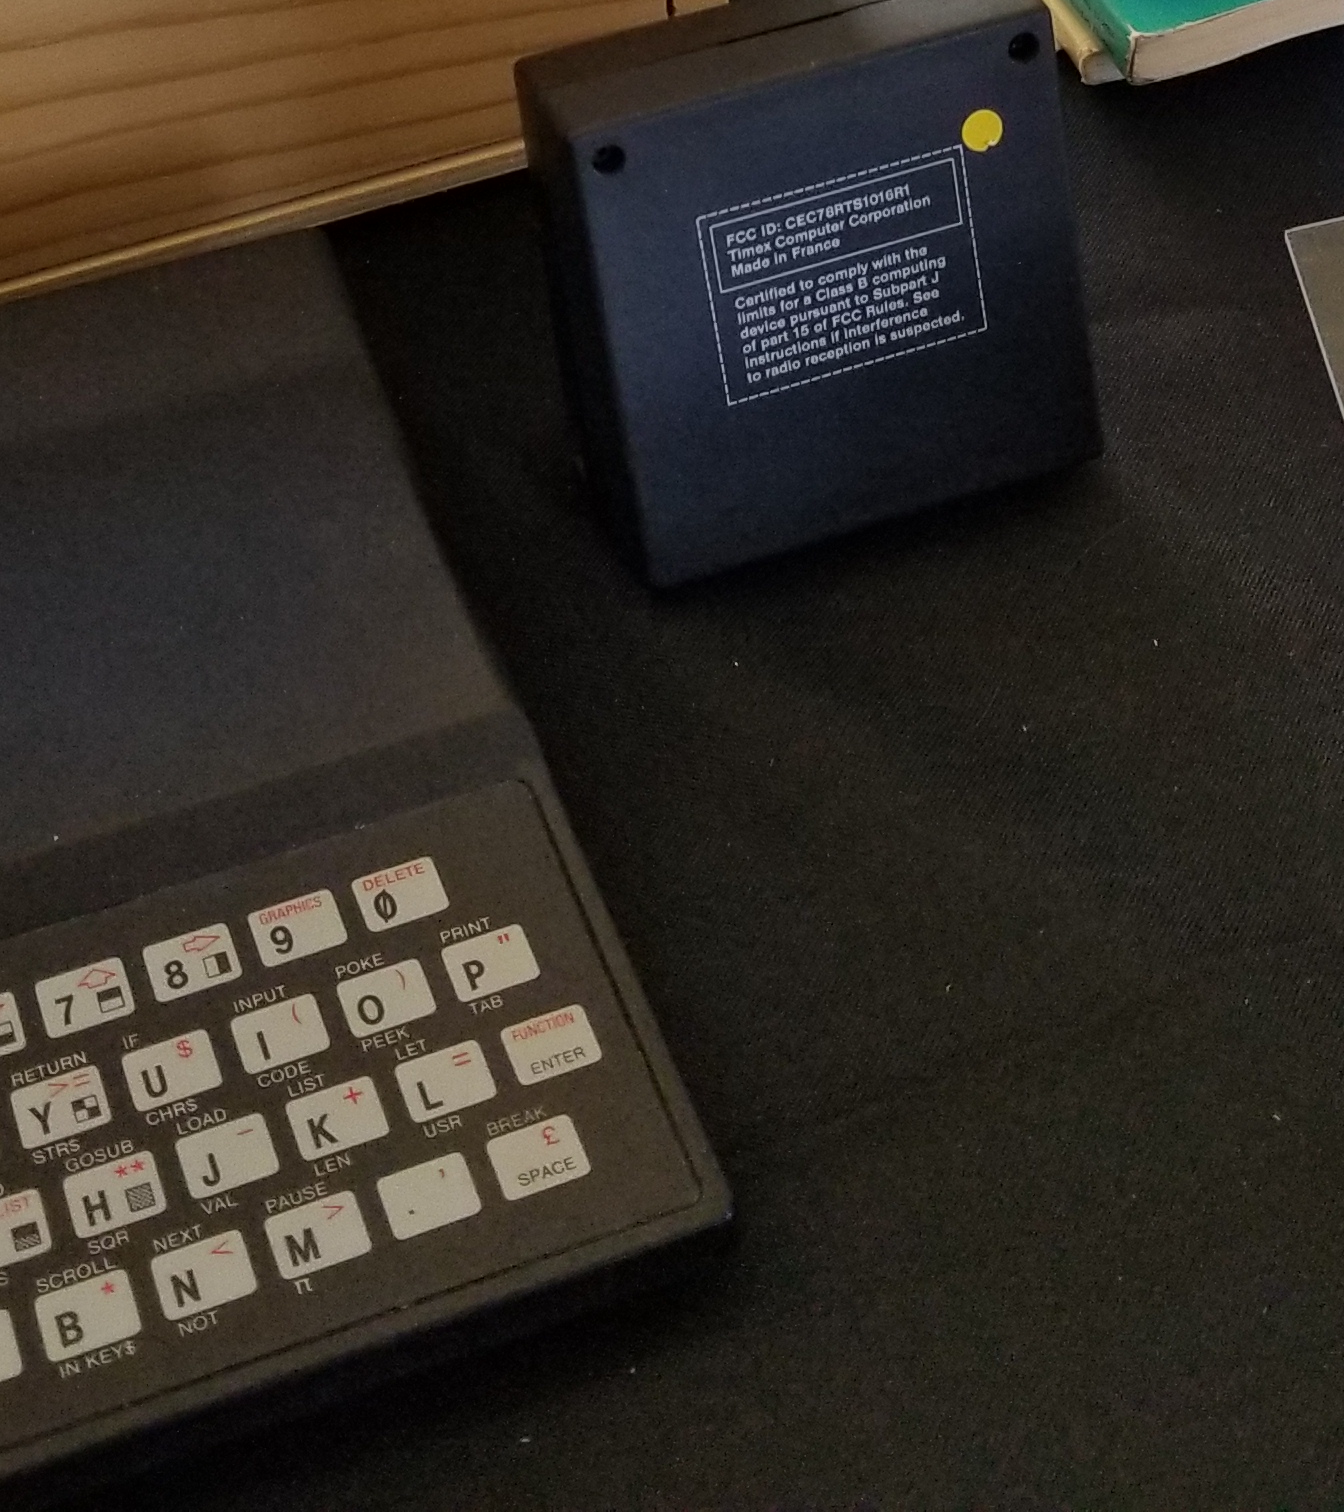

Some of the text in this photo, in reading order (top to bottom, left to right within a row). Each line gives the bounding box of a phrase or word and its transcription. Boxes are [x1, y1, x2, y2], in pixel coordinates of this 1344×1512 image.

[726, 228, 757, 248] FCC
[761, 223, 782, 237] ID:
[727, 195, 931, 261] Timex Computer Corporation
[731, 257, 770, 277] Made
[792, 237, 841, 260] France
[735, 243, 927, 309] Certified to comply with the
[737, 256, 946, 325] limits for a Class B computing
[747, 309, 965, 384] to radio reception is suspected.
[362, 863, 425, 892] DELETE
[259, 896, 322, 925] GRAPHICS
[270, 926, 293, 954] 9
[440, 917, 491, 943] PRINT
[164, 961, 188, 989] 8
[335, 953, 384, 978] POKE
[233, 985, 286, 1014] INPUT
[511, 1012, 574, 1043] FUNCTION
[10, 1052, 87, 1086] RETURN
[531, 1045, 585, 1076] ENTER
[517, 1157, 576, 1186] SPACE
